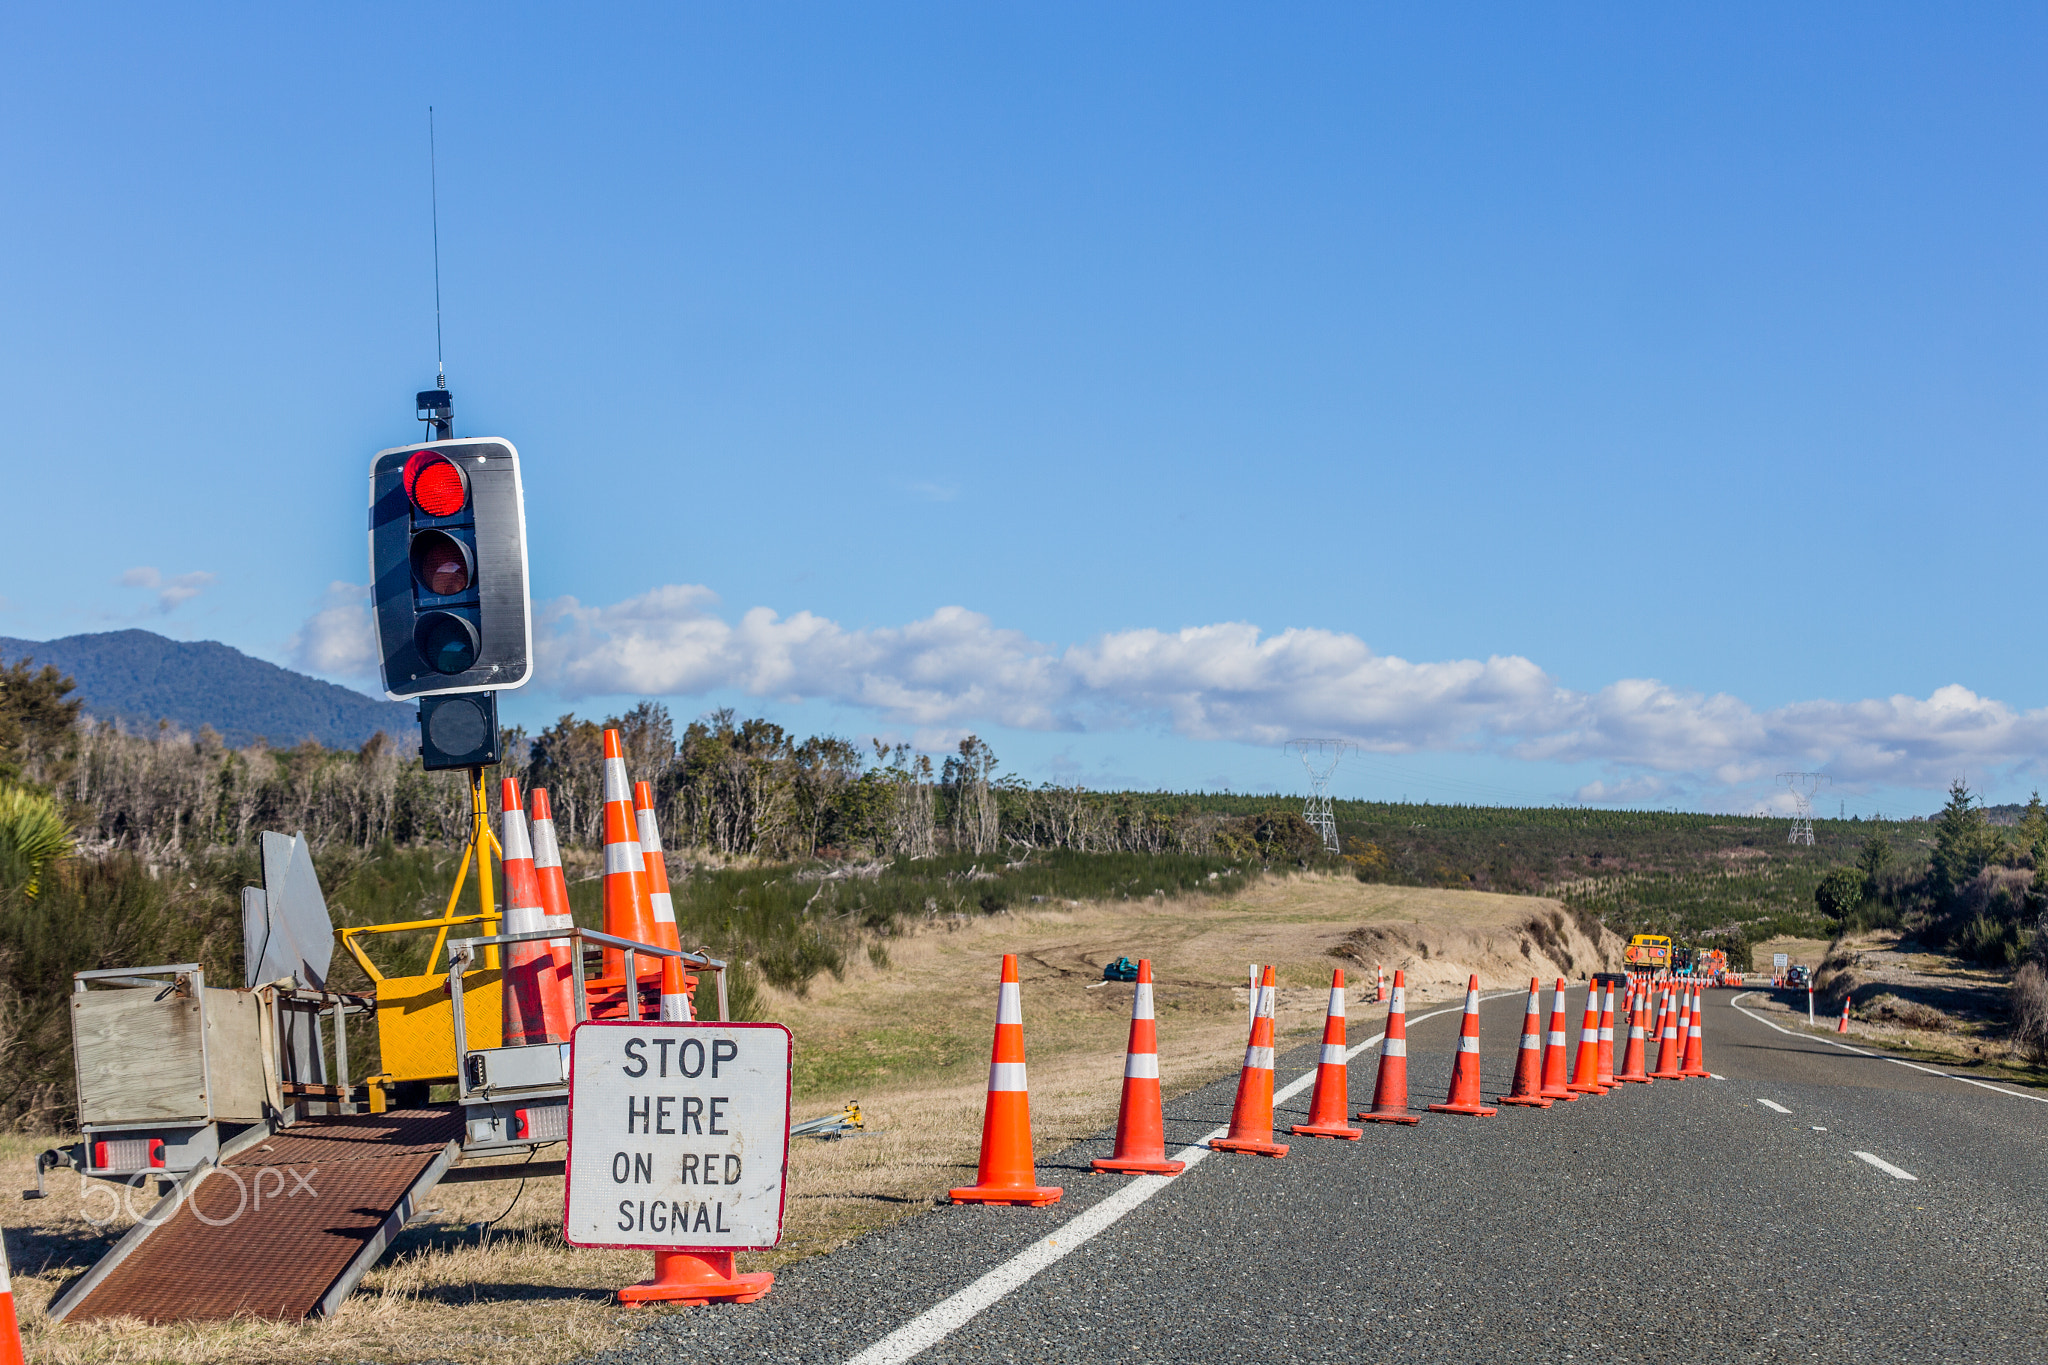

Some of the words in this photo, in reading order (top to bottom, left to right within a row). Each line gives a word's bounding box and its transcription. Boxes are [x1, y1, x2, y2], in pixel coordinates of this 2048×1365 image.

[622, 1037, 738, 1079] STOP
[628, 1095, 729, 1136] HERE
[612, 1151, 652, 1184] ON
[682, 1153, 742, 1185] RED
[617, 1199, 731, 1235] SIGNAL
